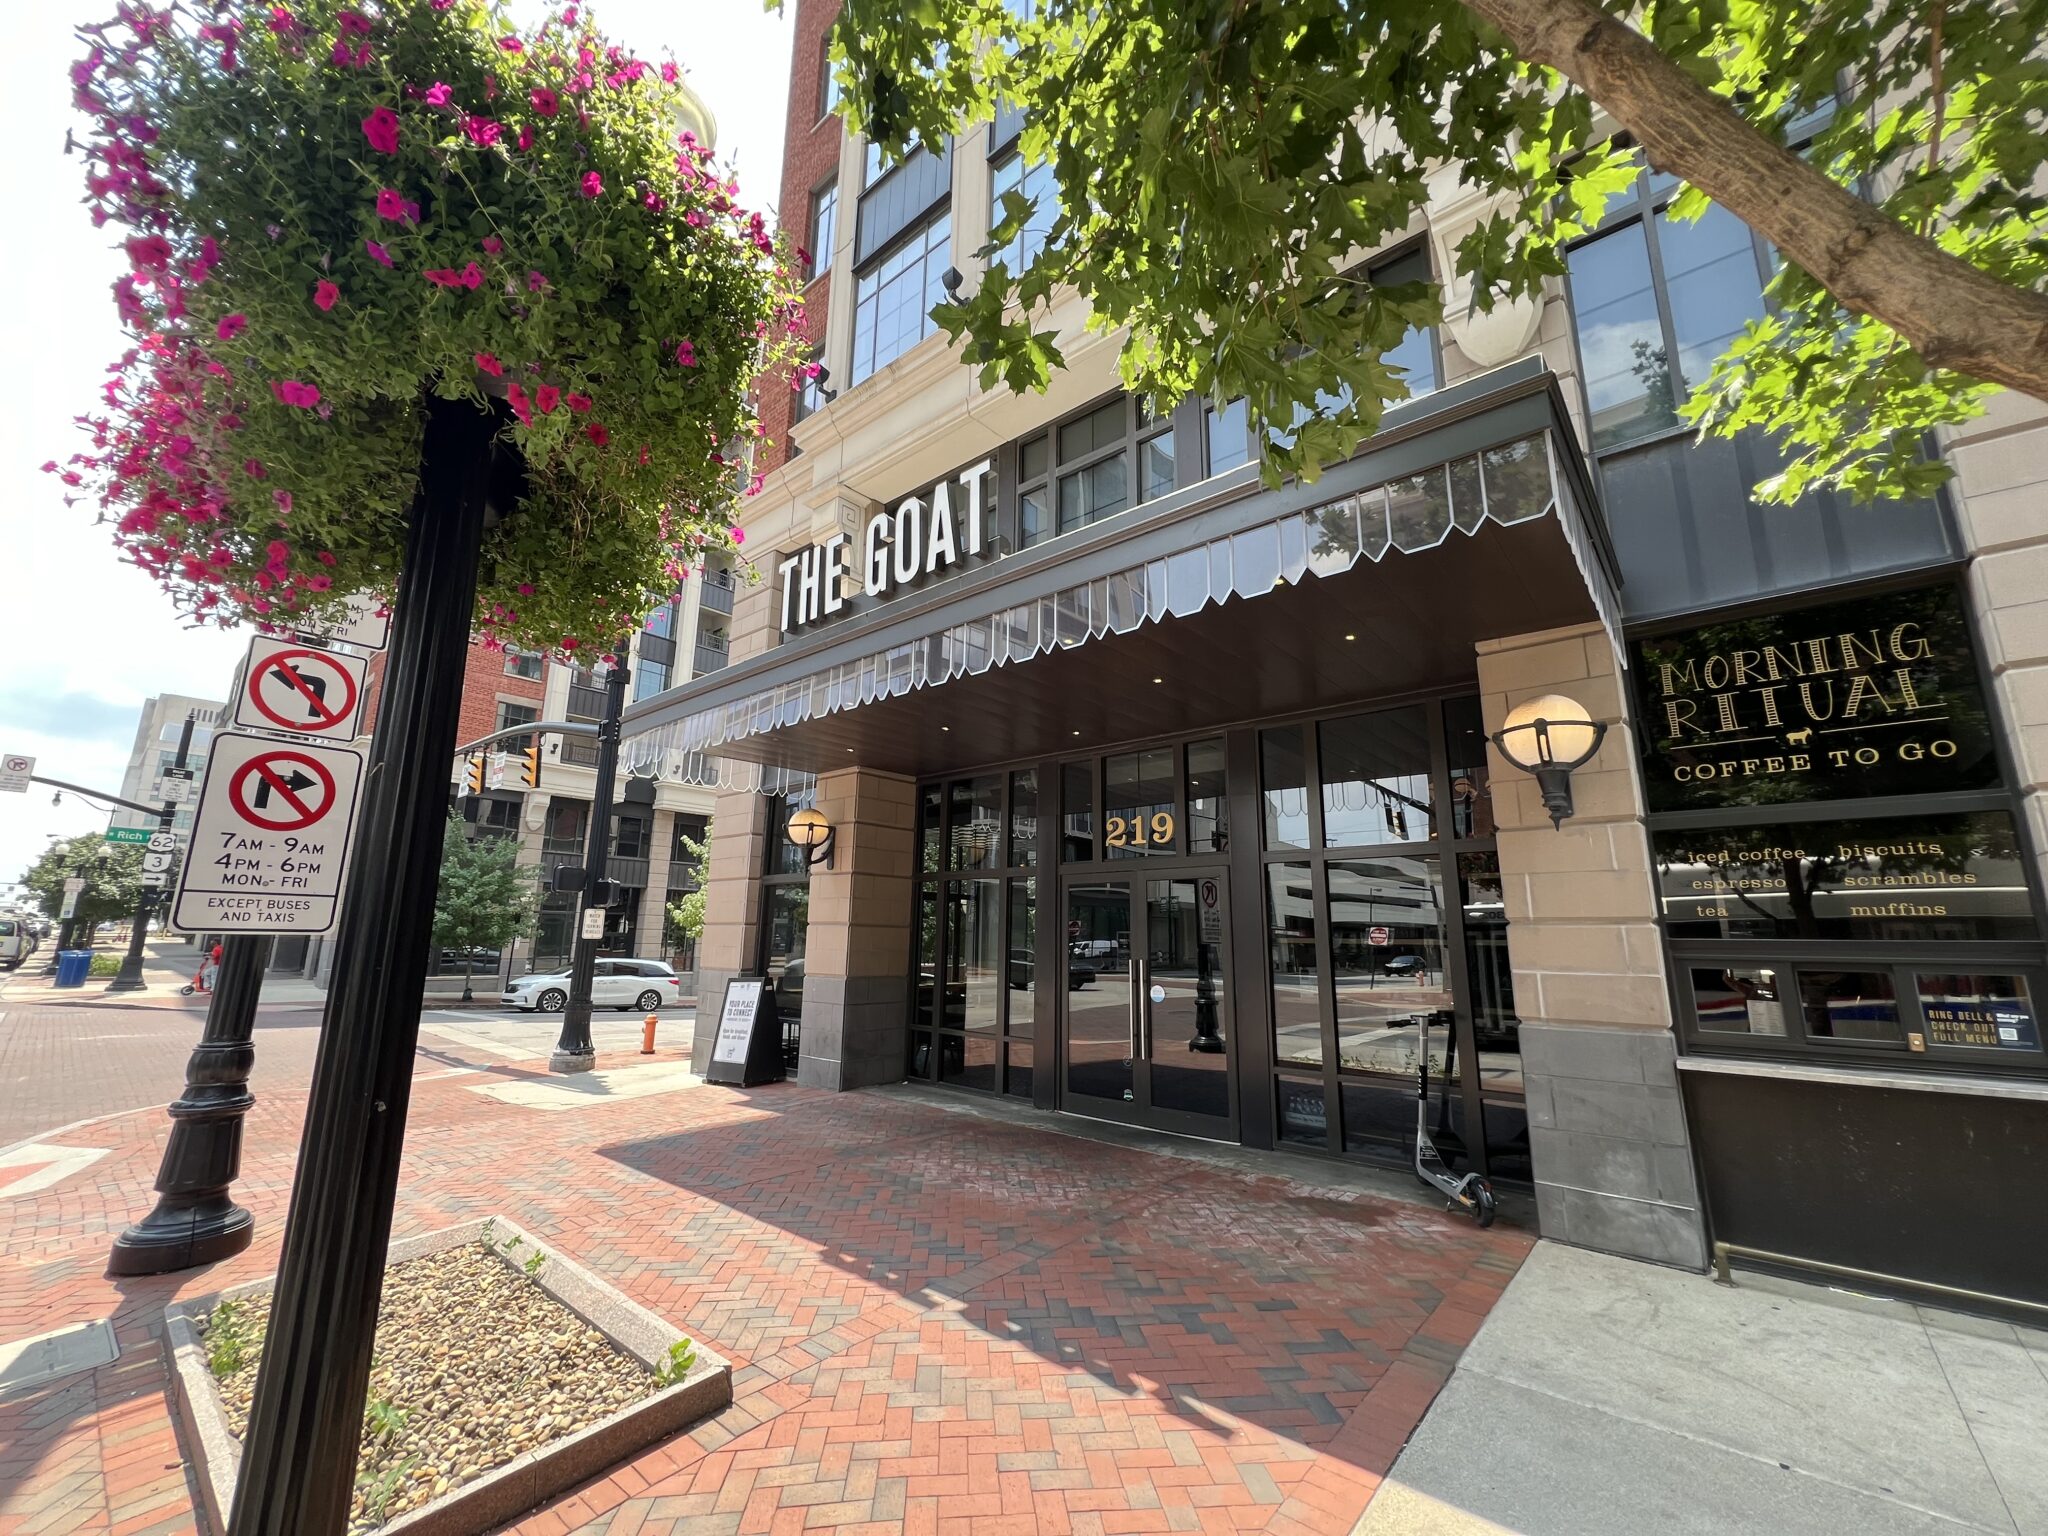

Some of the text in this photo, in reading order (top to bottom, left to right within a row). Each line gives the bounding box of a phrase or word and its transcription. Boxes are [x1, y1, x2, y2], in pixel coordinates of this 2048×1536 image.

[779, 458, 991, 633] THE GOAT
[1660, 622, 1935, 696] MORNING
[1663, 668, 1948, 738] RITUAL
[1674, 740, 1957, 782] COFFEE TO GO
[117, 831, 143, 840] Rich
[1105, 812, 1174, 847] 219
[151, 836, 173, 848] 62
[220, 832, 263, 850] 7AM
[284, 837, 324, 855] 9AM
[152, 857, 163, 868] 3
[1687, 847, 1806, 864] iced coffee
[214, 853, 260, 871] 4PM
[281, 857, 321, 874] 6PM
[281, 876, 308, 888] FRI
[1692, 876, 1787, 892] espresso
[1844, 871, 1978, 888] scrambles
[207, 897, 311, 911] EXCEPT BUSES
[1850, 902, 1947, 917] muffins
[220, 912, 295, 923] AND TAXIS
[1697, 905, 1729, 918] tea
[729, 1000, 756, 1008] YOUR PLACE
[727, 1008, 733, 1016] TO
[1928, 1009, 1953, 1020] RING
[1958, 1010, 1984, 1021] BELL
[1986, 1013, 1994, 1021] &
[1931, 1022, 1967, 1031] CHECK
[1974, 1023, 1996, 1033] OUT
[1933, 1032, 1960, 1042] FULL
[1966, 1034, 1997, 1044] MENU
